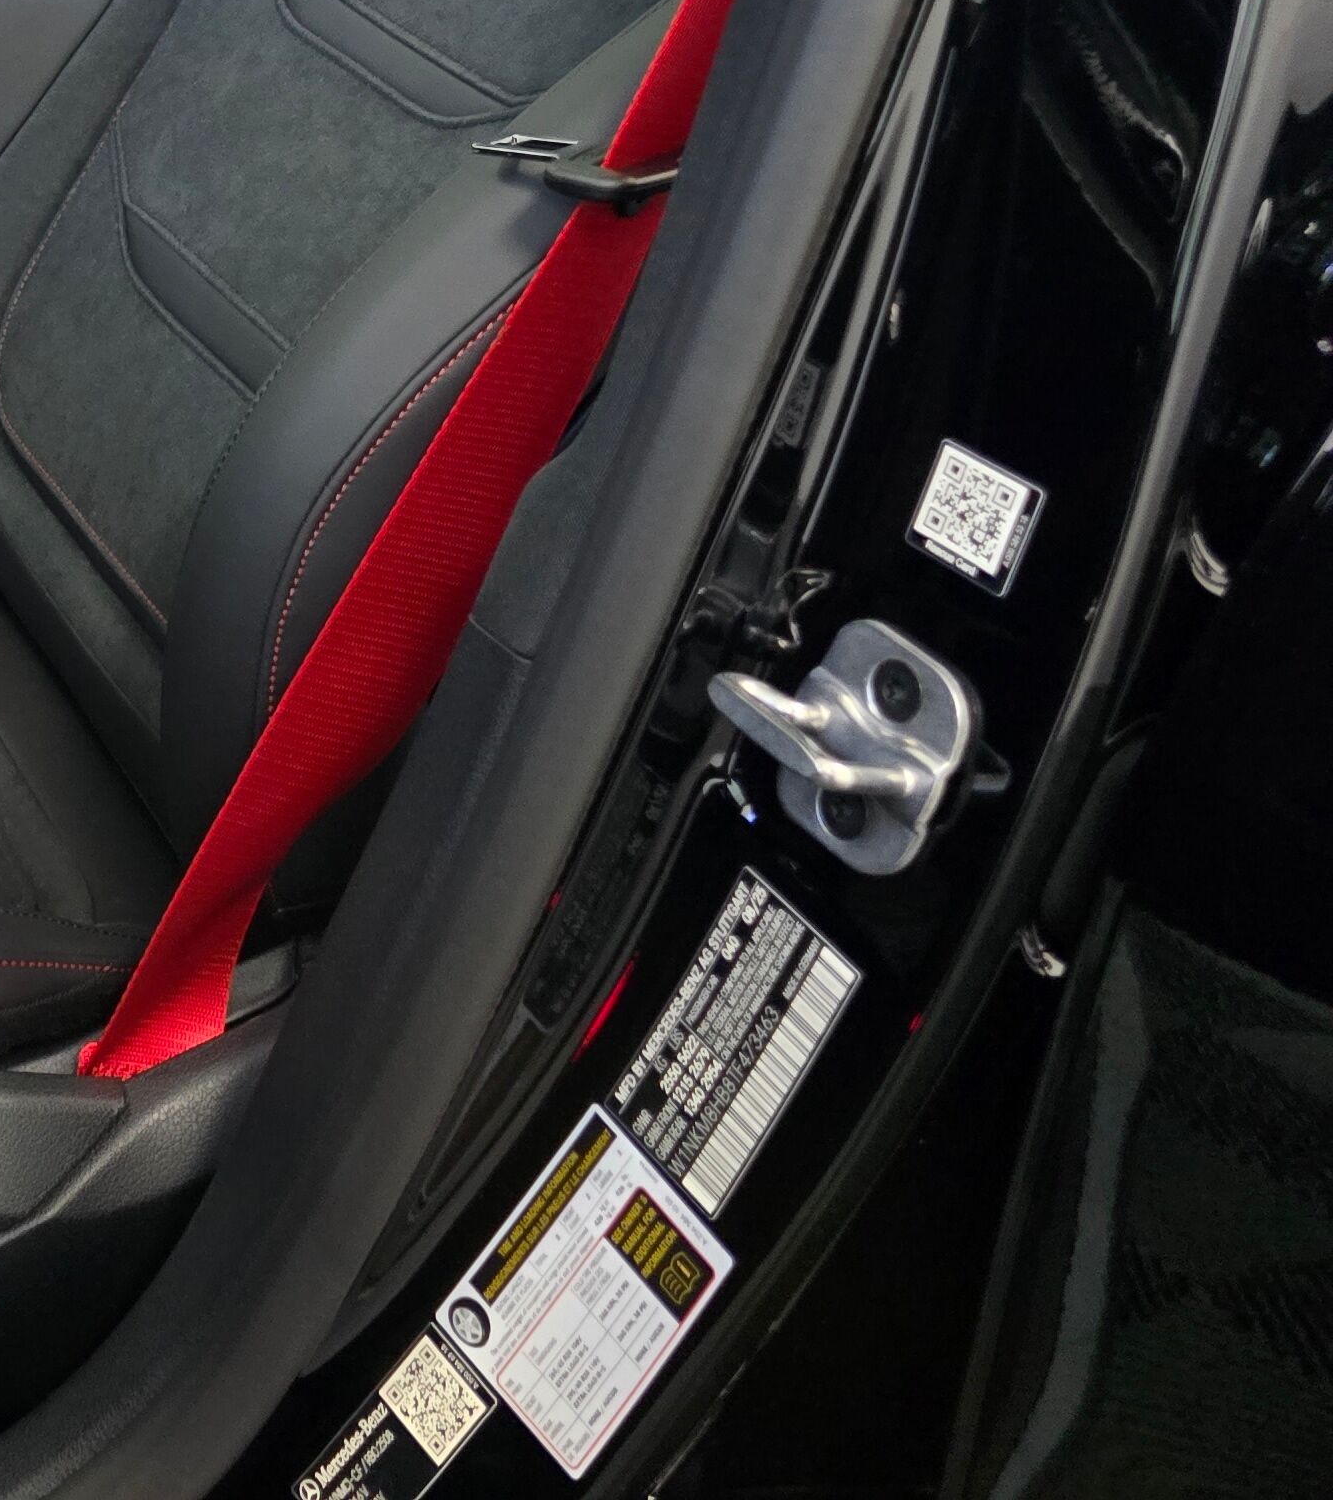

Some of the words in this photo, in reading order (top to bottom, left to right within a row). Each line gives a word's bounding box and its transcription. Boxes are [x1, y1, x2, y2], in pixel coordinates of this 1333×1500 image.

[924, 538, 956, 564] Rescue
[954, 556, 977, 576] Card
[704, 880, 752, 951] STUTTGART
[695, 945, 714, 970] AG
[719, 931, 742, 962] 040
[640, 962, 704, 1063] MERCEDES-BENZ
[630, 1054, 648, 1078] BY
[652, 1053, 668, 1075] KG
[666, 1026, 685, 1051] LBS
[657, 1059, 684, 1096] 2550
[675, 1032, 700, 1067] 5622
[613, 1070, 638, 1105] MFD
[666, 1001, 781, 1181] W1NKM8HB8TF473463
[671, 1072, 695, 1106] 1215
[687, 1045, 712, 1080] 2679
[682, 1084, 706, 1118] 1340
[699, 1057, 723, 1092] 2954
[655, 1096, 678, 1129] FRONT
[667, 1113, 687, 1141] REAR
[312, 1398, 389, 1488] Mercedes-Benz
